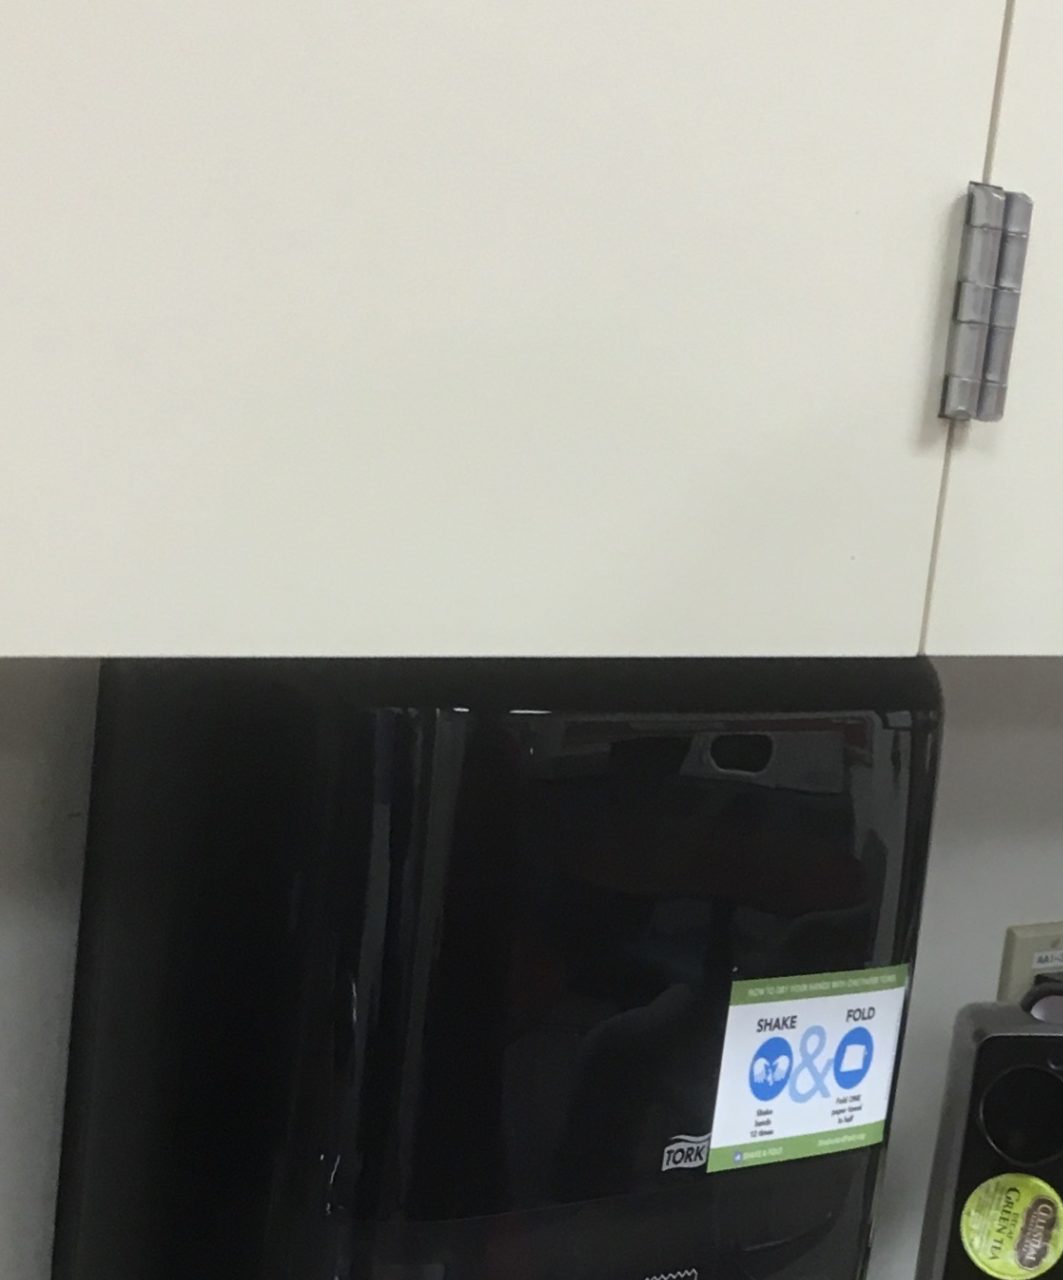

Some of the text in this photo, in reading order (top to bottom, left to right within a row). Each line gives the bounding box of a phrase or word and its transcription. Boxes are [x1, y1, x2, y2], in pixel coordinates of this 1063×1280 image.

[756, 1015, 798, 1033] SHAKE
[845, 1006, 876, 1023] FOLD
[788, 1025, 834, 1104] &
[664, 1147, 704, 1166] TORK
[989, 1187, 1020, 1260] GREEN TEA
[1025, 1203, 1053, 1261] CELESTIAL
